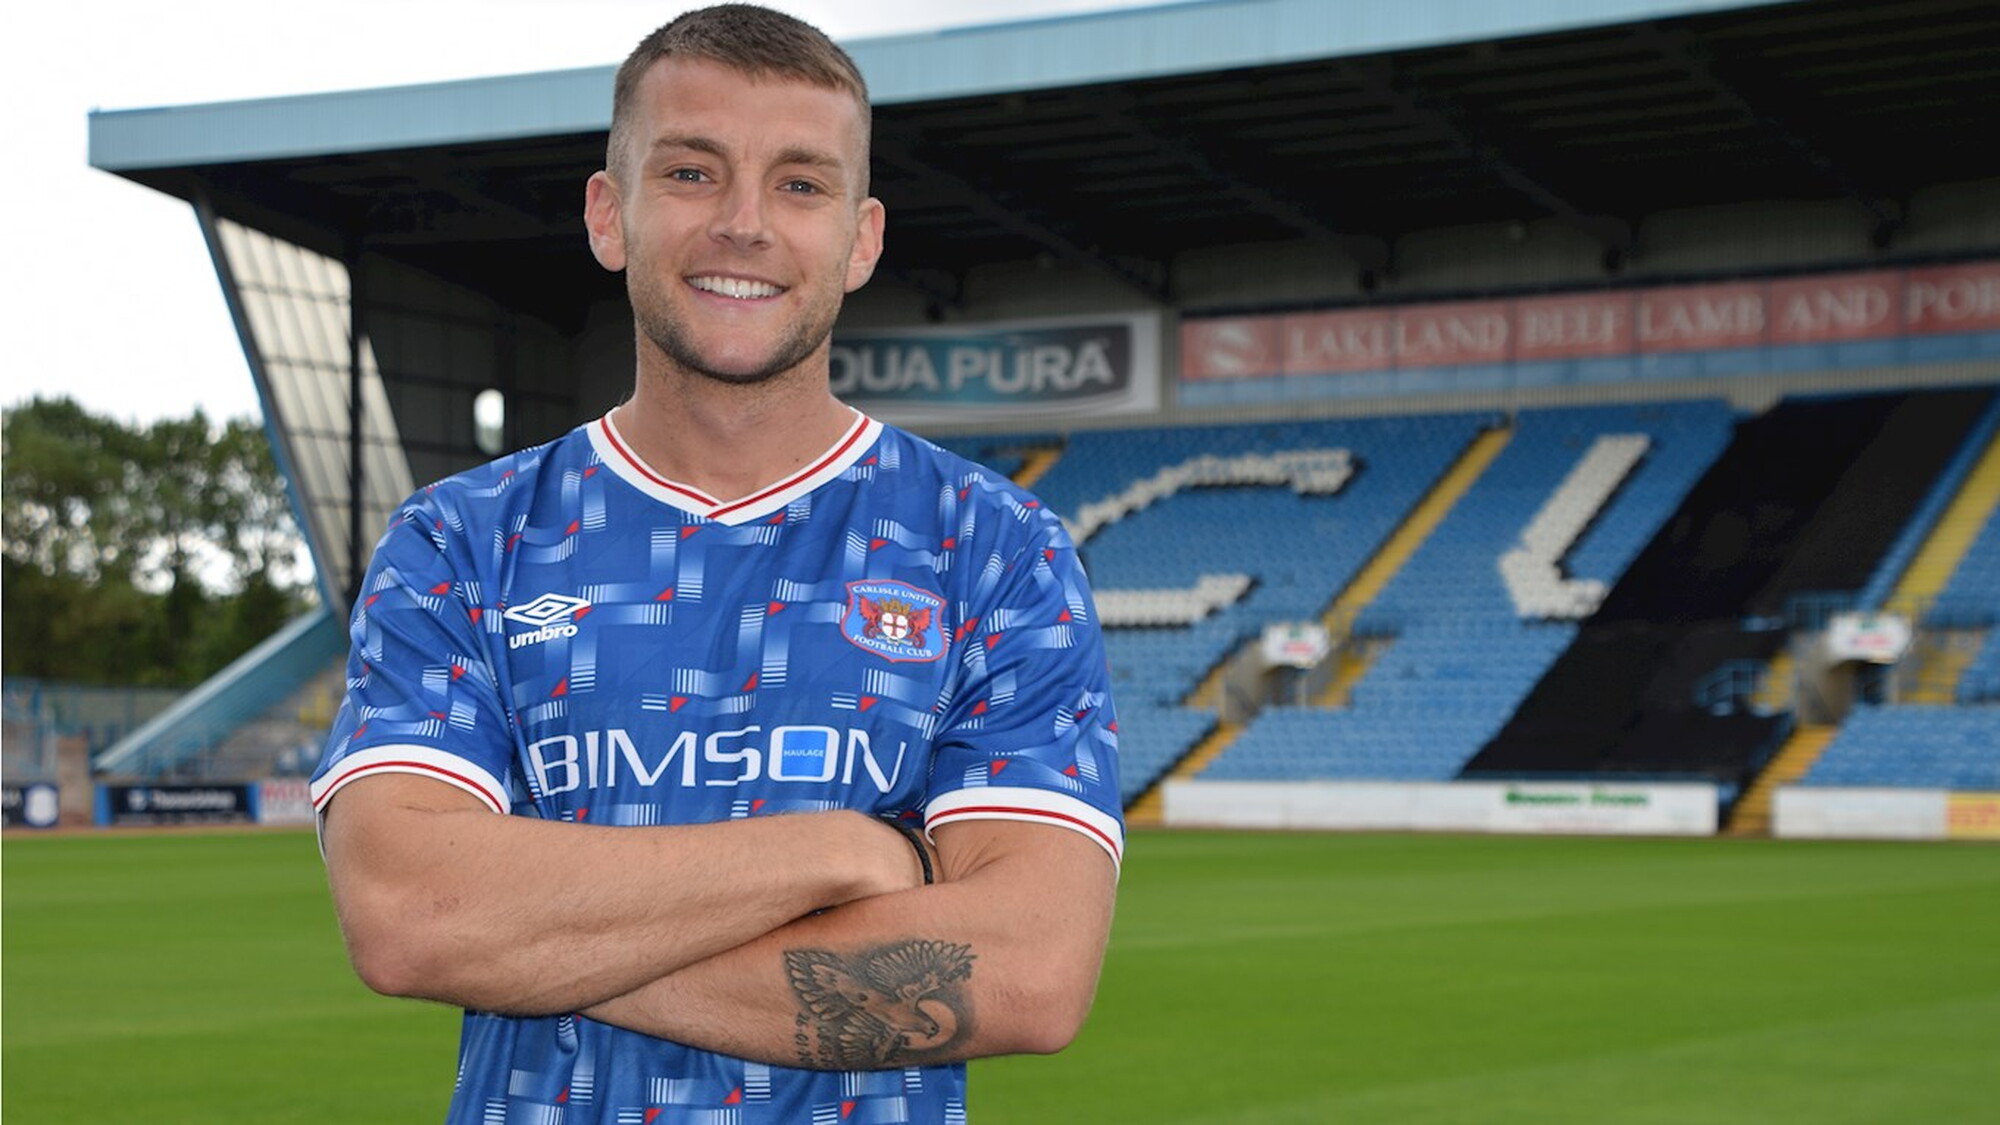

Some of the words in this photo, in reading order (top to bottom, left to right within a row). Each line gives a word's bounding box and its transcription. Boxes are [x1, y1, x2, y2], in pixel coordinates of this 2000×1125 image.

[1638, 294, 1766, 341] LAMB
[1780, 285, 1889, 332] AND
[829, 346, 939, 393] QUA
[852, 586, 900, 597] CARLISLE
[901, 590, 940, 607] UNITED
[509, 624, 579, 650] umbro
[853, 634, 903, 654] FOOTBALL
[906, 647, 933, 657] CLUB
[528, 725, 906, 797] BIMSON
[783, 748, 824, 757] HAULAGE
